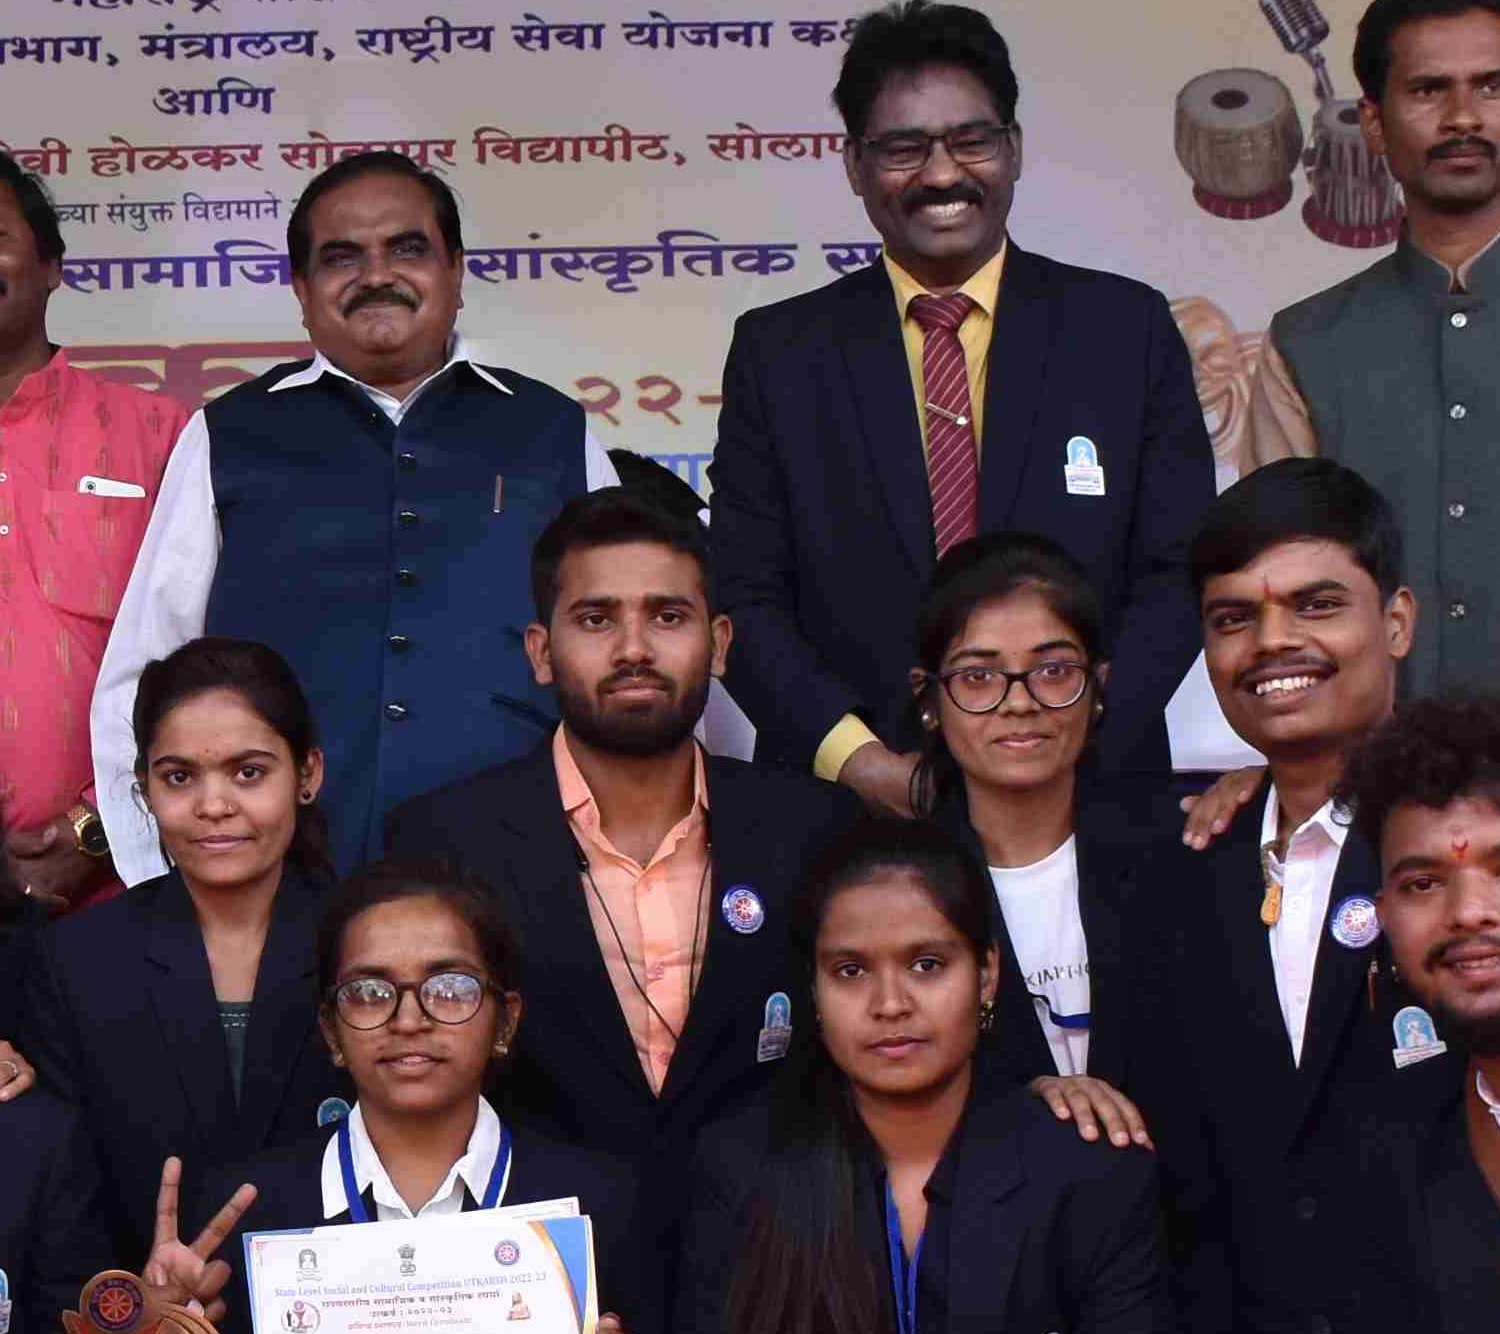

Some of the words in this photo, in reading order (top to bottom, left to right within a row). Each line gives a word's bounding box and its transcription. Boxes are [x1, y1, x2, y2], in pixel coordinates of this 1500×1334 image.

[139, 23, 335, 63] मंत्रालय,
[356, 16, 494, 62] राष्ट्रीय
[511, 12, 604, 52] सेवा
[622, 11, 773, 48] योजना
[152, 77, 275, 115] आणि
[88, 136, 262, 177] होळकर
[473, 124, 686, 166] विद्यापीठ,
[107, 194, 173, 230] संयुक्त
[183, 191, 280, 220] विद्यमाने
[465, 230, 798, 293] सांस्कृतिक
